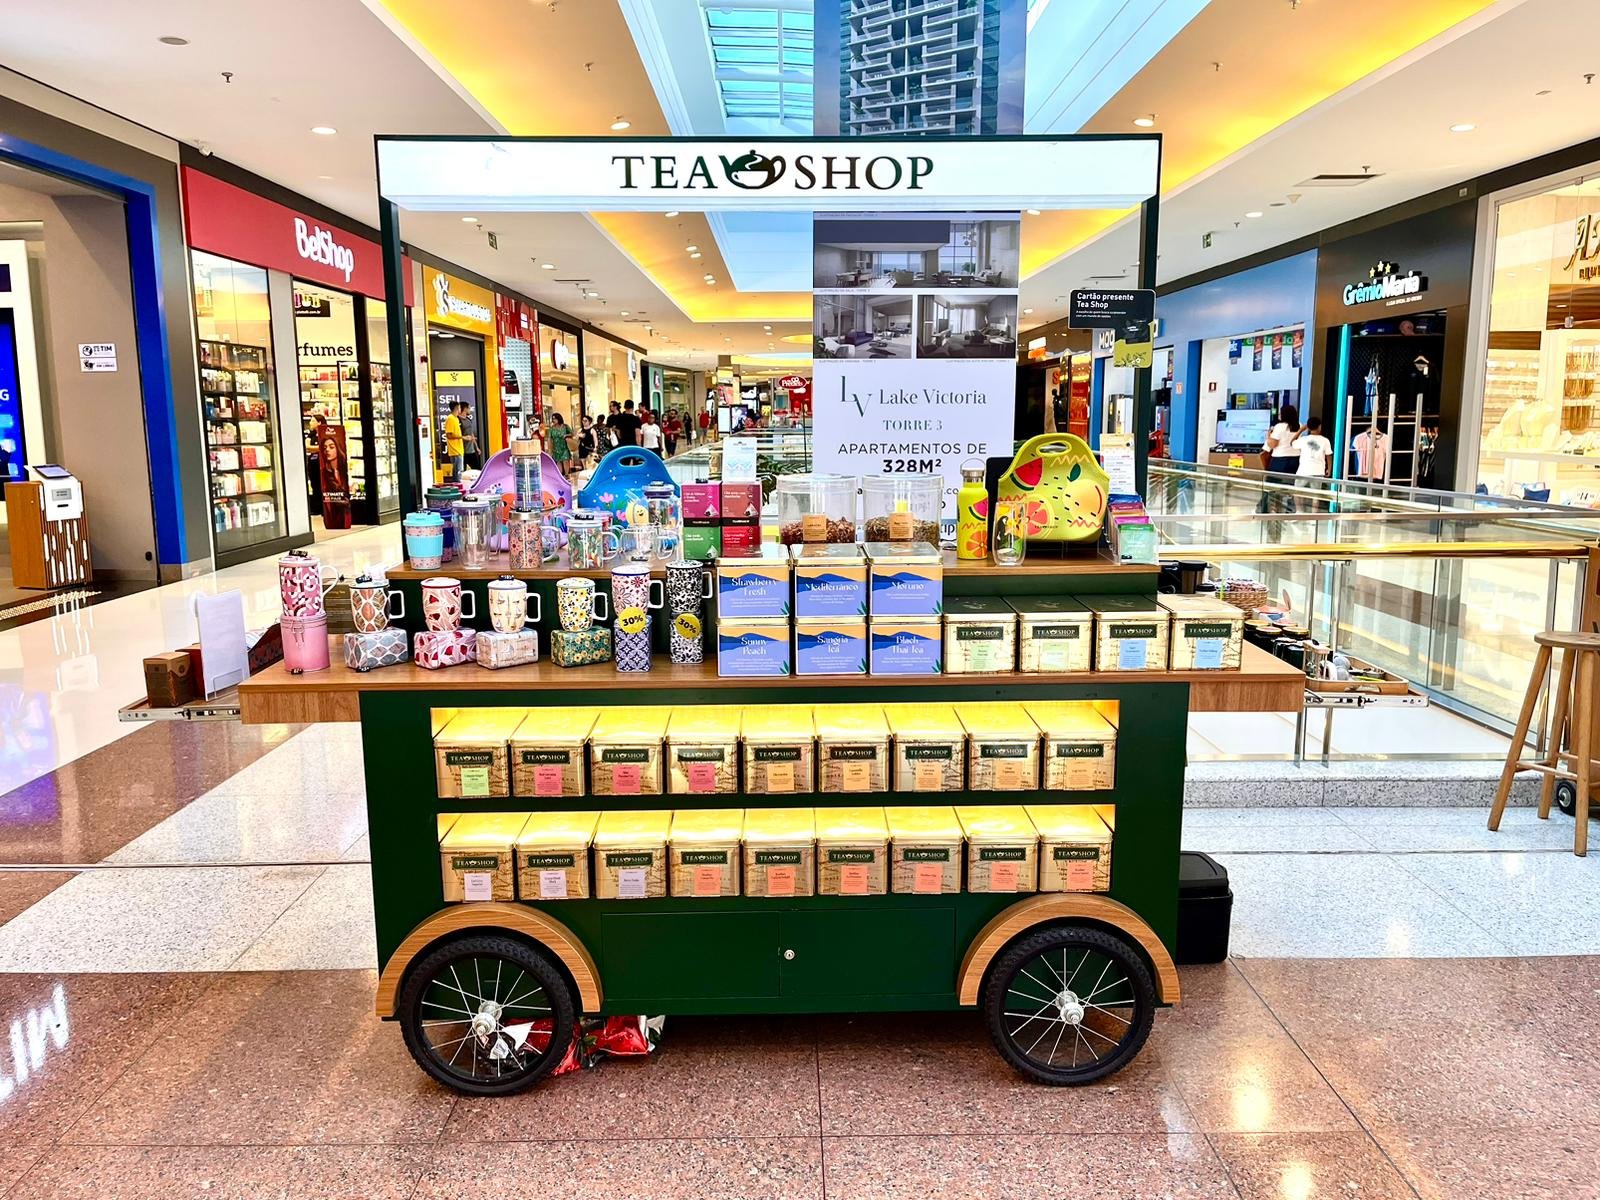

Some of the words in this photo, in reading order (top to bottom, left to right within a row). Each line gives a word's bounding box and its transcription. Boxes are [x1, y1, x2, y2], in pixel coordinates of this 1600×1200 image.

[611, 156, 718, 189] TEA
[794, 155, 934, 190] SHOP
[294, 217, 354, 283] BelShop
[1077, 292, 1101, 300] Cartão
[1090, 301, 1109, 309] Shop
[880, 389, 918, 405] Lake
[924, 389, 987, 405] Victoria
[882, 419, 932, 431] TORRE
[936, 419, 943, 431] 3
[838, 443, 961, 455] APARTAMENTOS
[967, 443, 987, 455] DE
[622, 615, 644, 627] 30%
[678, 618, 697, 634] 30%
